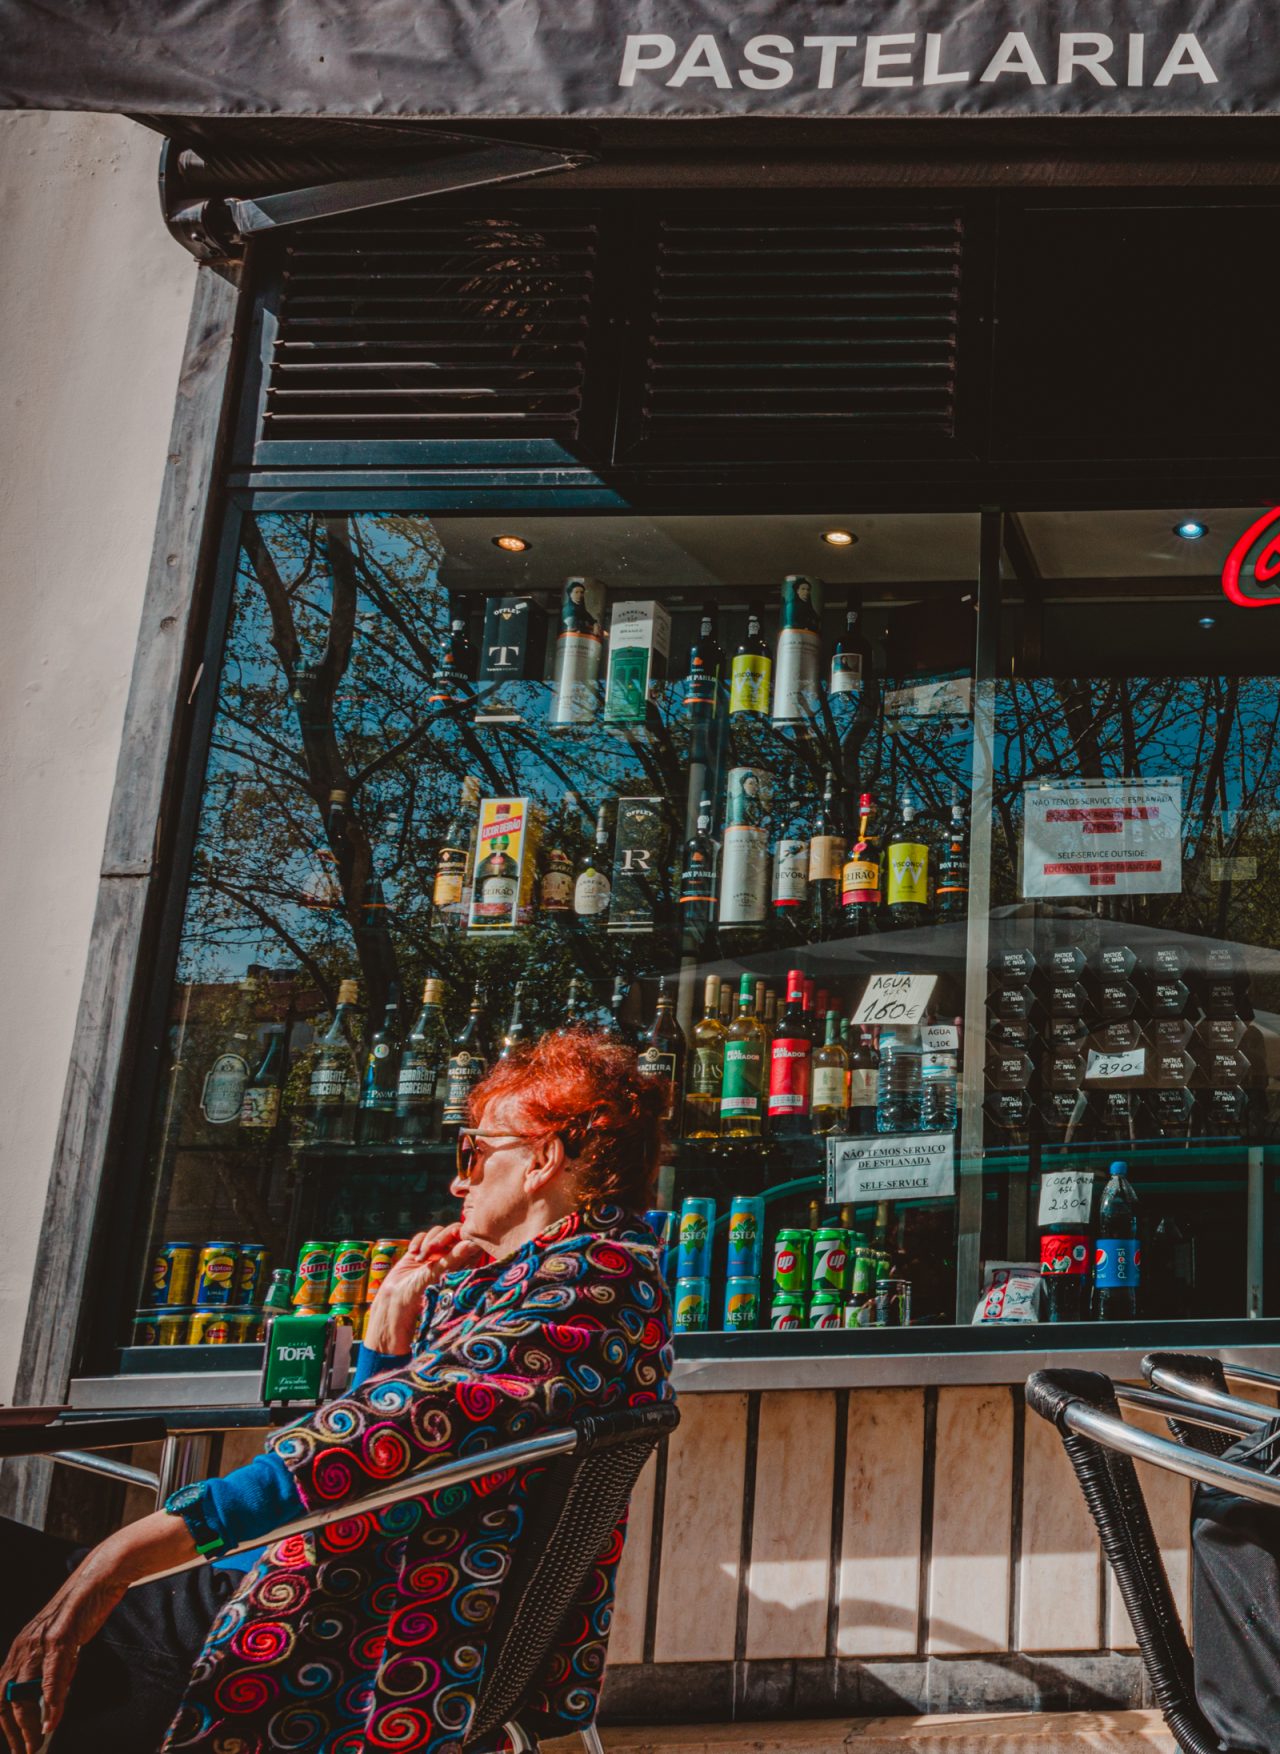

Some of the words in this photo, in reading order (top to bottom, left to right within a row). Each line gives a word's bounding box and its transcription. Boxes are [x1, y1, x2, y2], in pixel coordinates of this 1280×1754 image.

[618, 31, 1218, 90] PASTELARIA
[488, 645, 520, 666] T
[1032, 796, 1050, 807] NÃO
[1081, 797, 1113, 807] SERVIÇO
[1128, 795, 1173, 804] ESPLANADA
[624, 809, 653, 818] OFFLEY
[621, 849, 652, 870] R
[1057, 850, 1109, 860] SELF-SERVICE
[1110, 849, 1148, 859] OUTSIDE:
[928, 1027, 951, 1036] ÁGUA
[843, 1148, 865, 1160] NÃO
[868, 1148, 901, 1159] TEMOS
[858, 1160, 872, 1170] DE
[874, 1156, 931, 1168] ESPLANADA
[859, 1177, 929, 1191] SELF-SERVICE
[209, 1263, 233, 1272] Lipton
[1115, 1247, 1127, 1279] pepsi
[276, 1345, 317, 1361] TOFA
